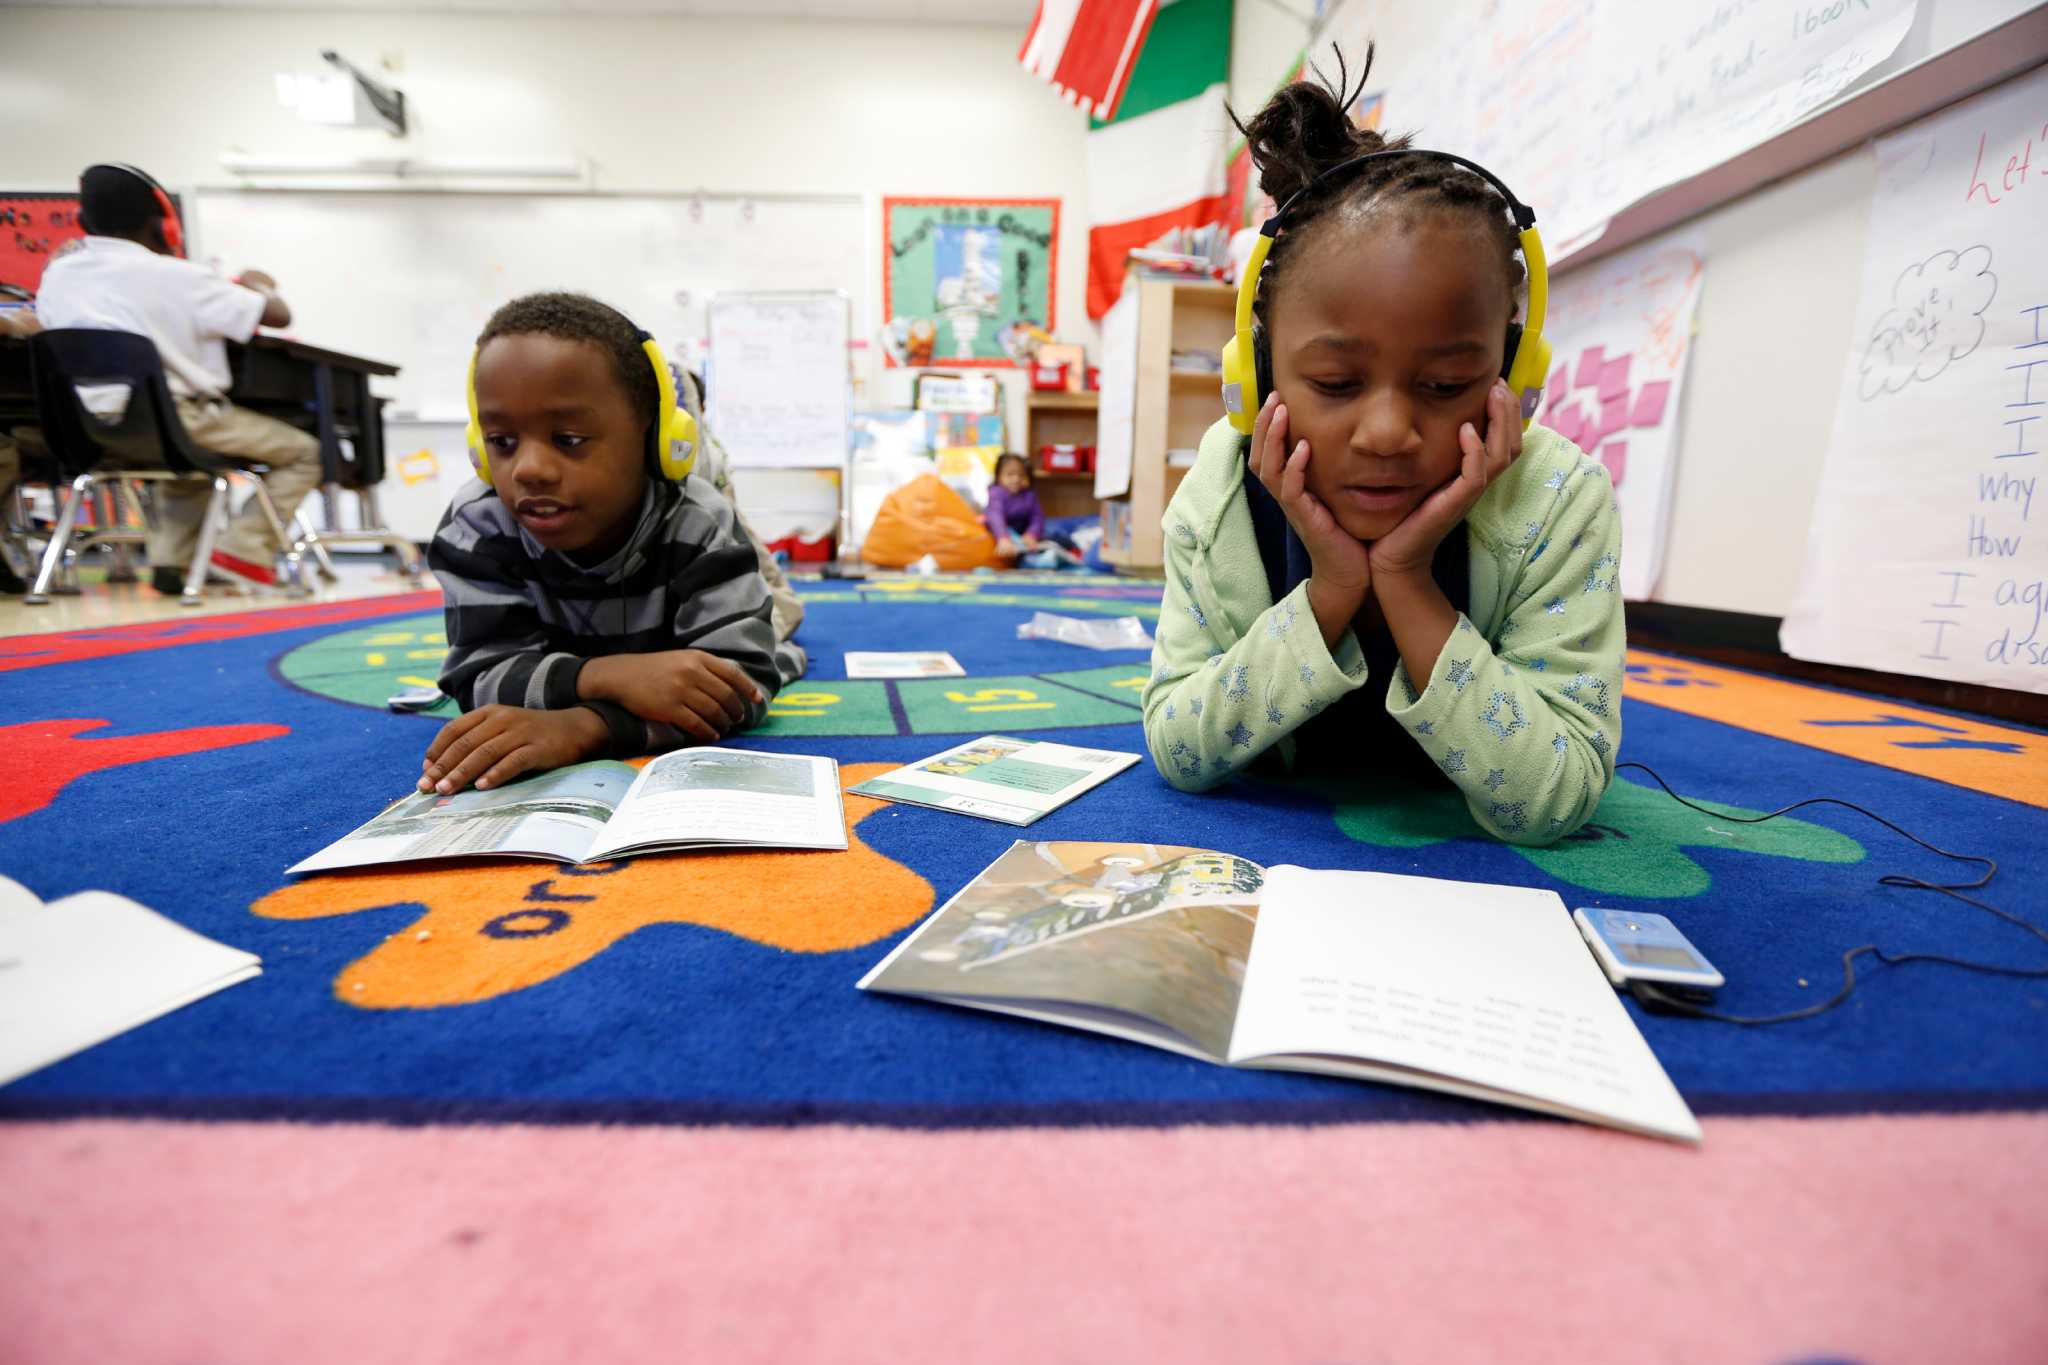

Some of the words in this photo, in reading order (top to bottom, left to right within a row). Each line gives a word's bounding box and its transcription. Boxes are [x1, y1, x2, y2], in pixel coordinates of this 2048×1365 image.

[1967, 511, 2022, 558] How
[1930, 570, 1977, 609] I
[1919, 618, 1961, 661] I
